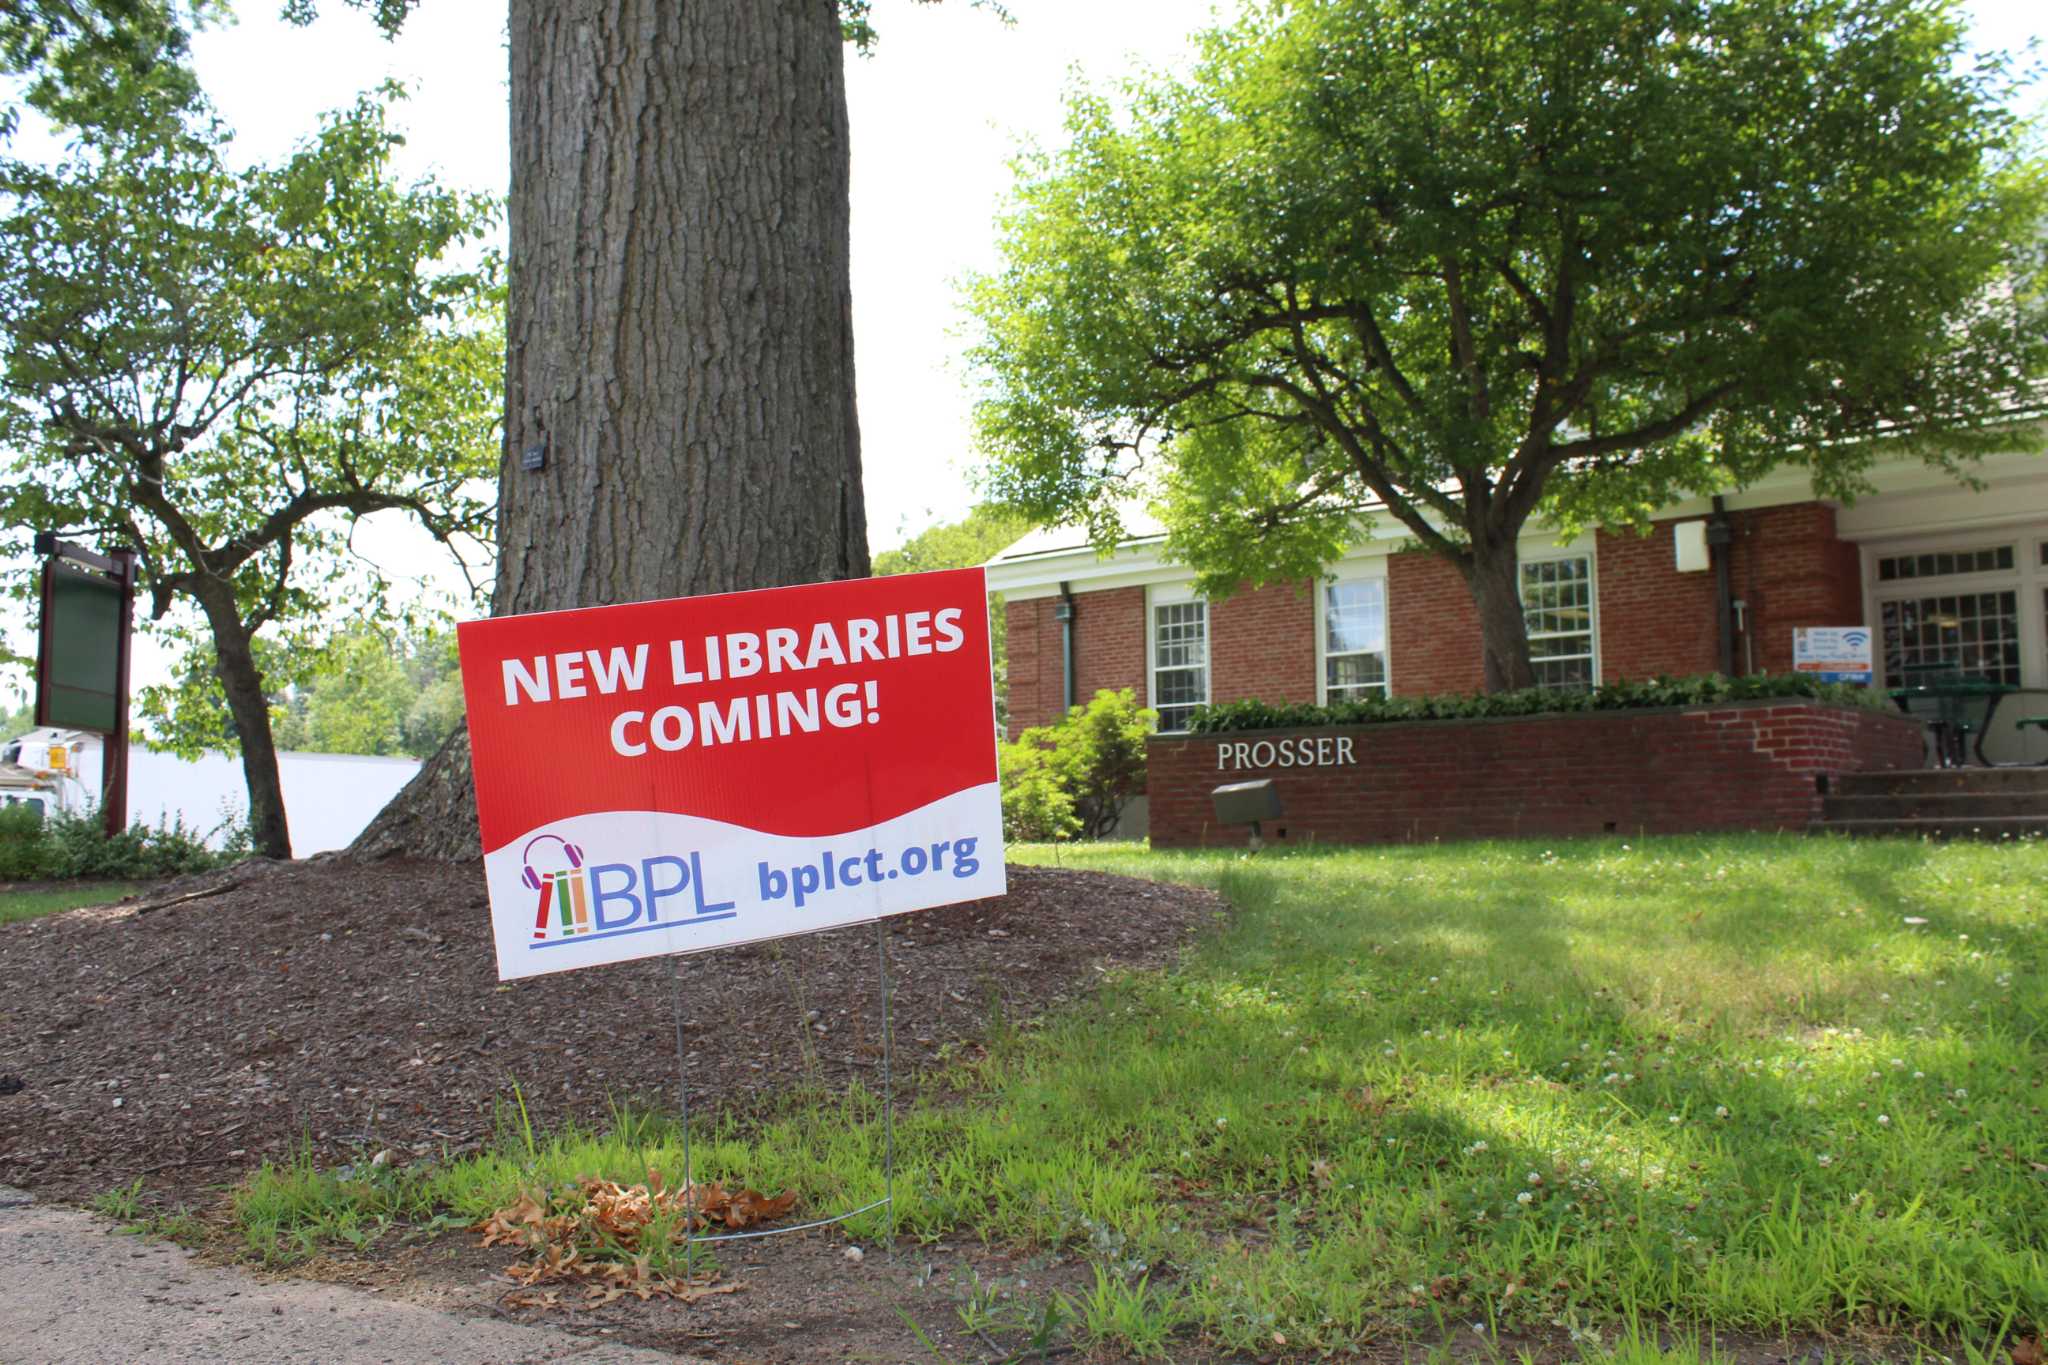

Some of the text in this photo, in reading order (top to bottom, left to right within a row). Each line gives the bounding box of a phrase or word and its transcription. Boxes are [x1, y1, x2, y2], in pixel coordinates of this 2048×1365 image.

[501, 607, 965, 706] NEW LIBRARIES
[609, 680, 881, 758] COMING!
[1217, 736, 1357, 770] PROSSER
[589, 851, 735, 931] BPL
[758, 835, 979, 907] bplct.org
